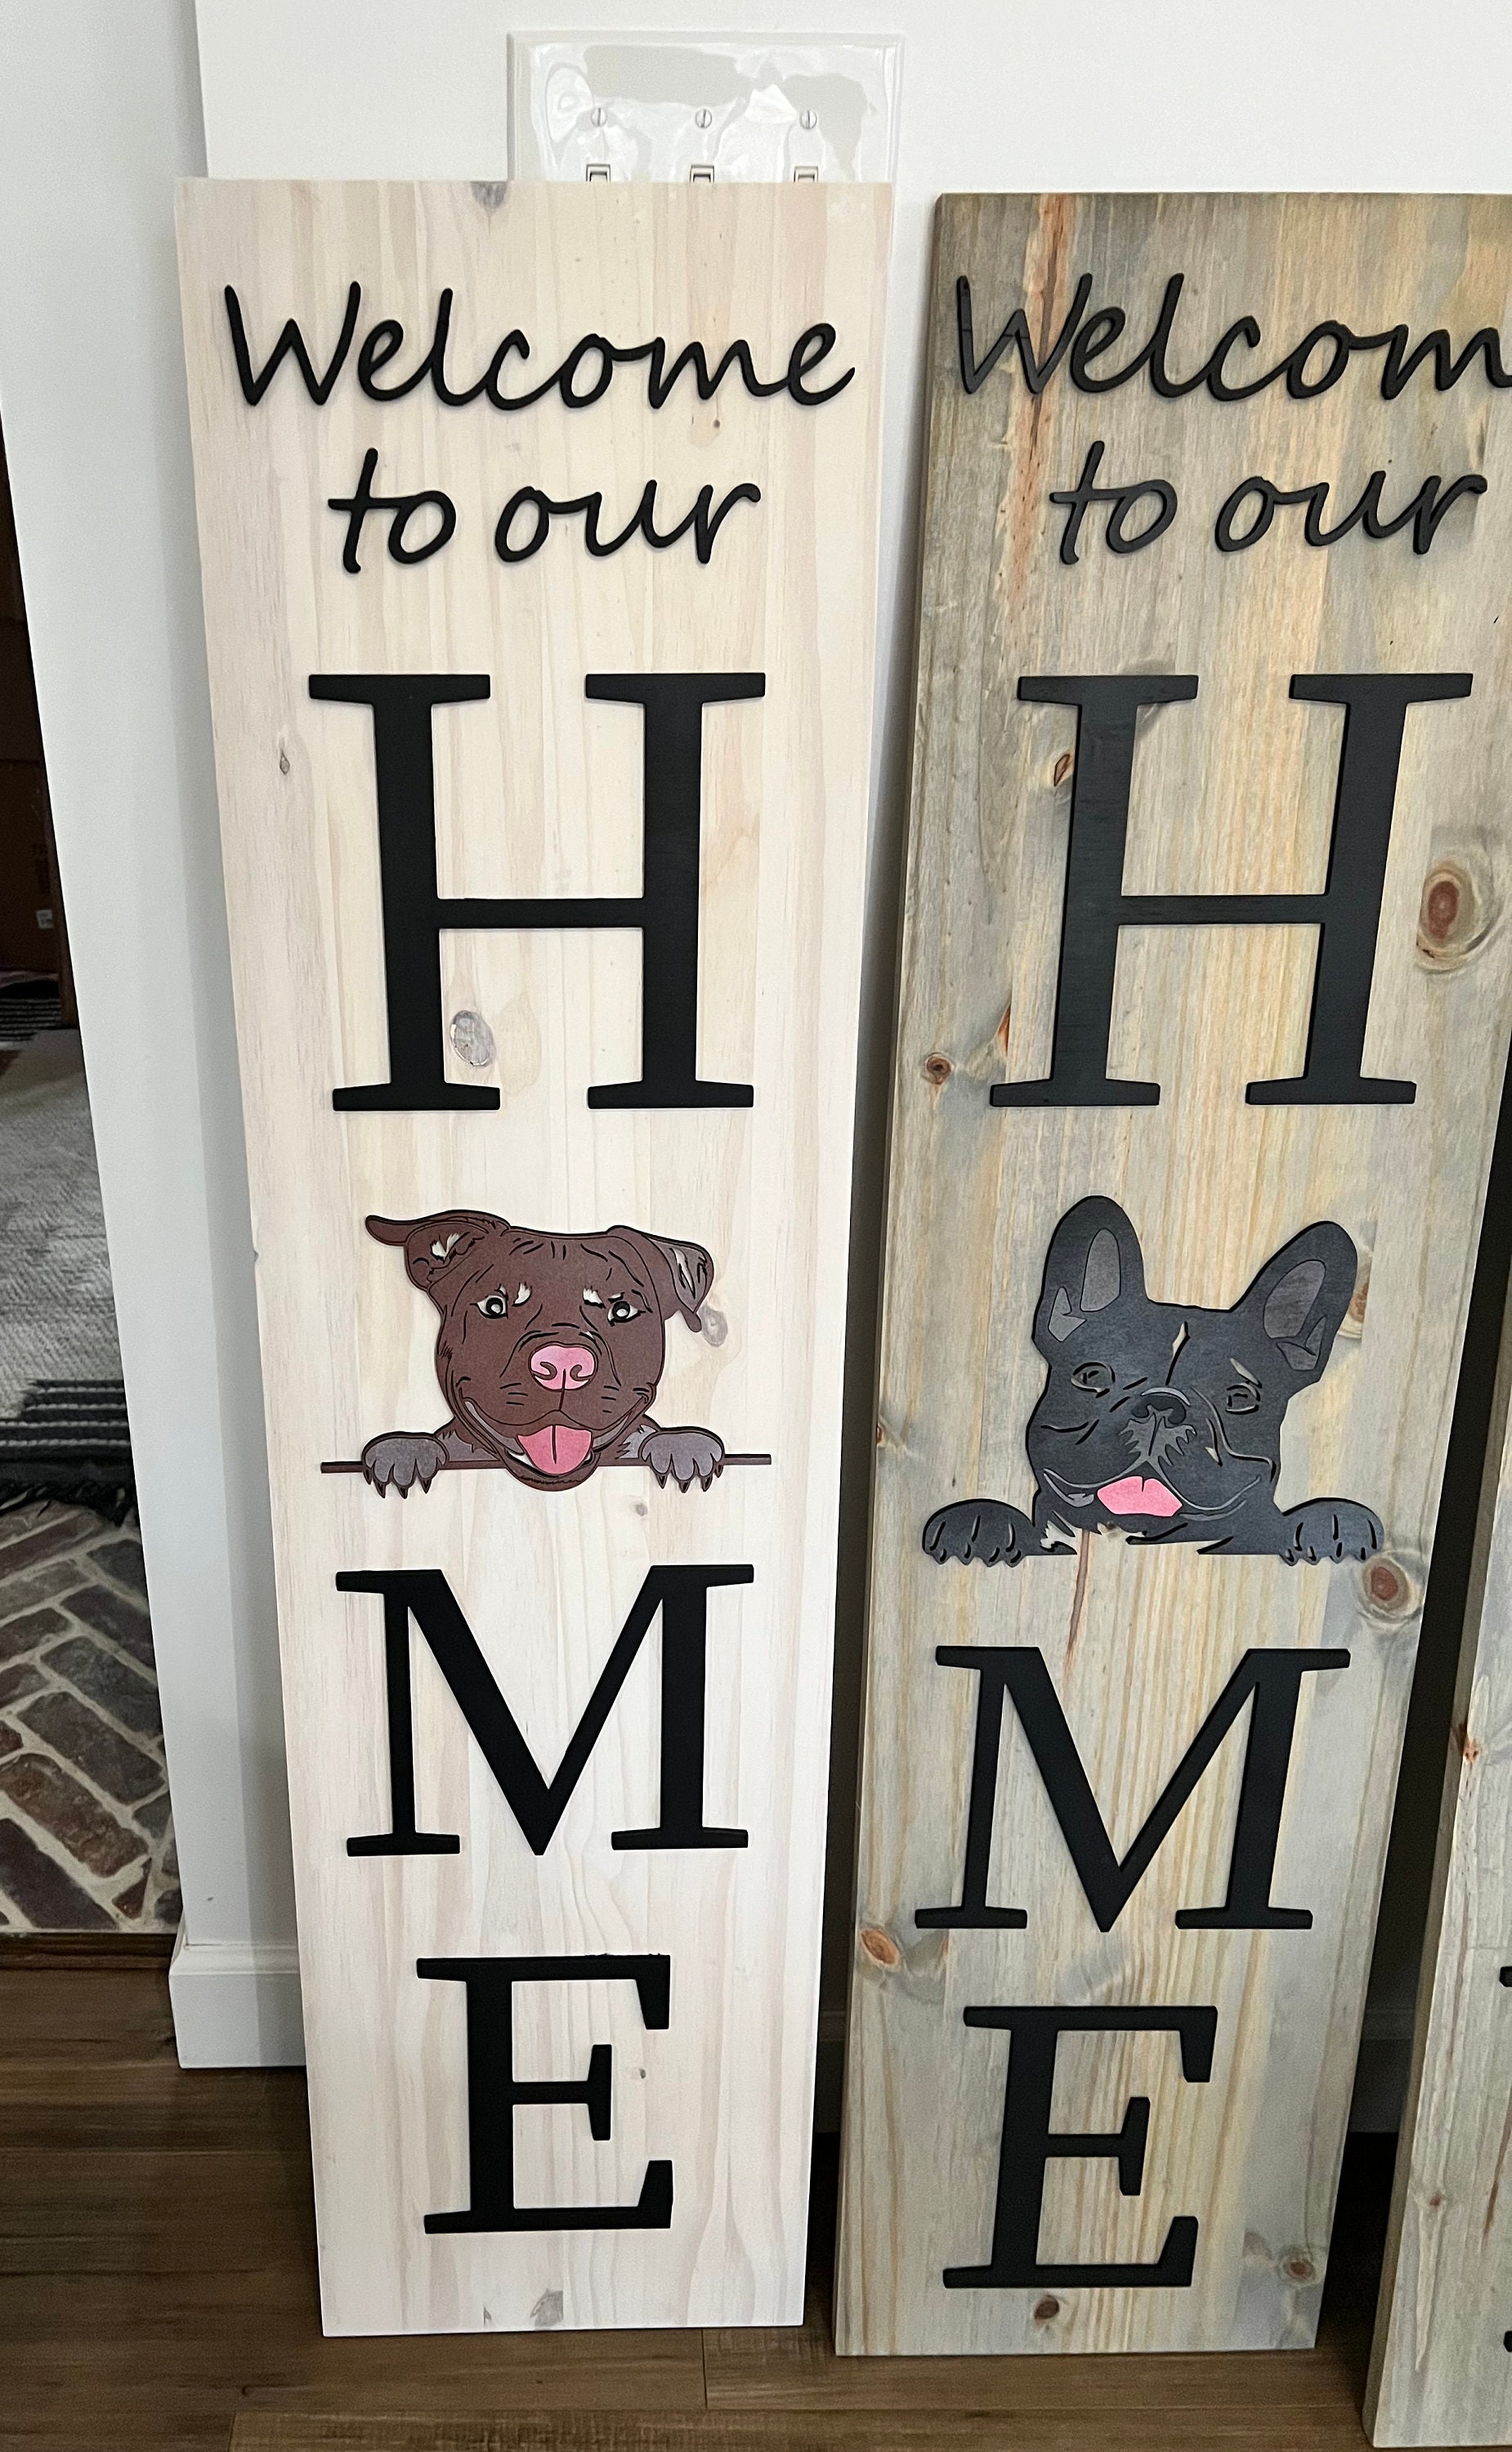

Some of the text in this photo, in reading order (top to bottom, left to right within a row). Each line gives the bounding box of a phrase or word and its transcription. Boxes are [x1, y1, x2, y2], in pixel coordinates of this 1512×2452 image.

[224, 280, 856, 411] Welcome
[955, 272, 1512, 403] Welcom
[327, 448, 762, 575] to our
[1049, 440, 1488, 566] to our
